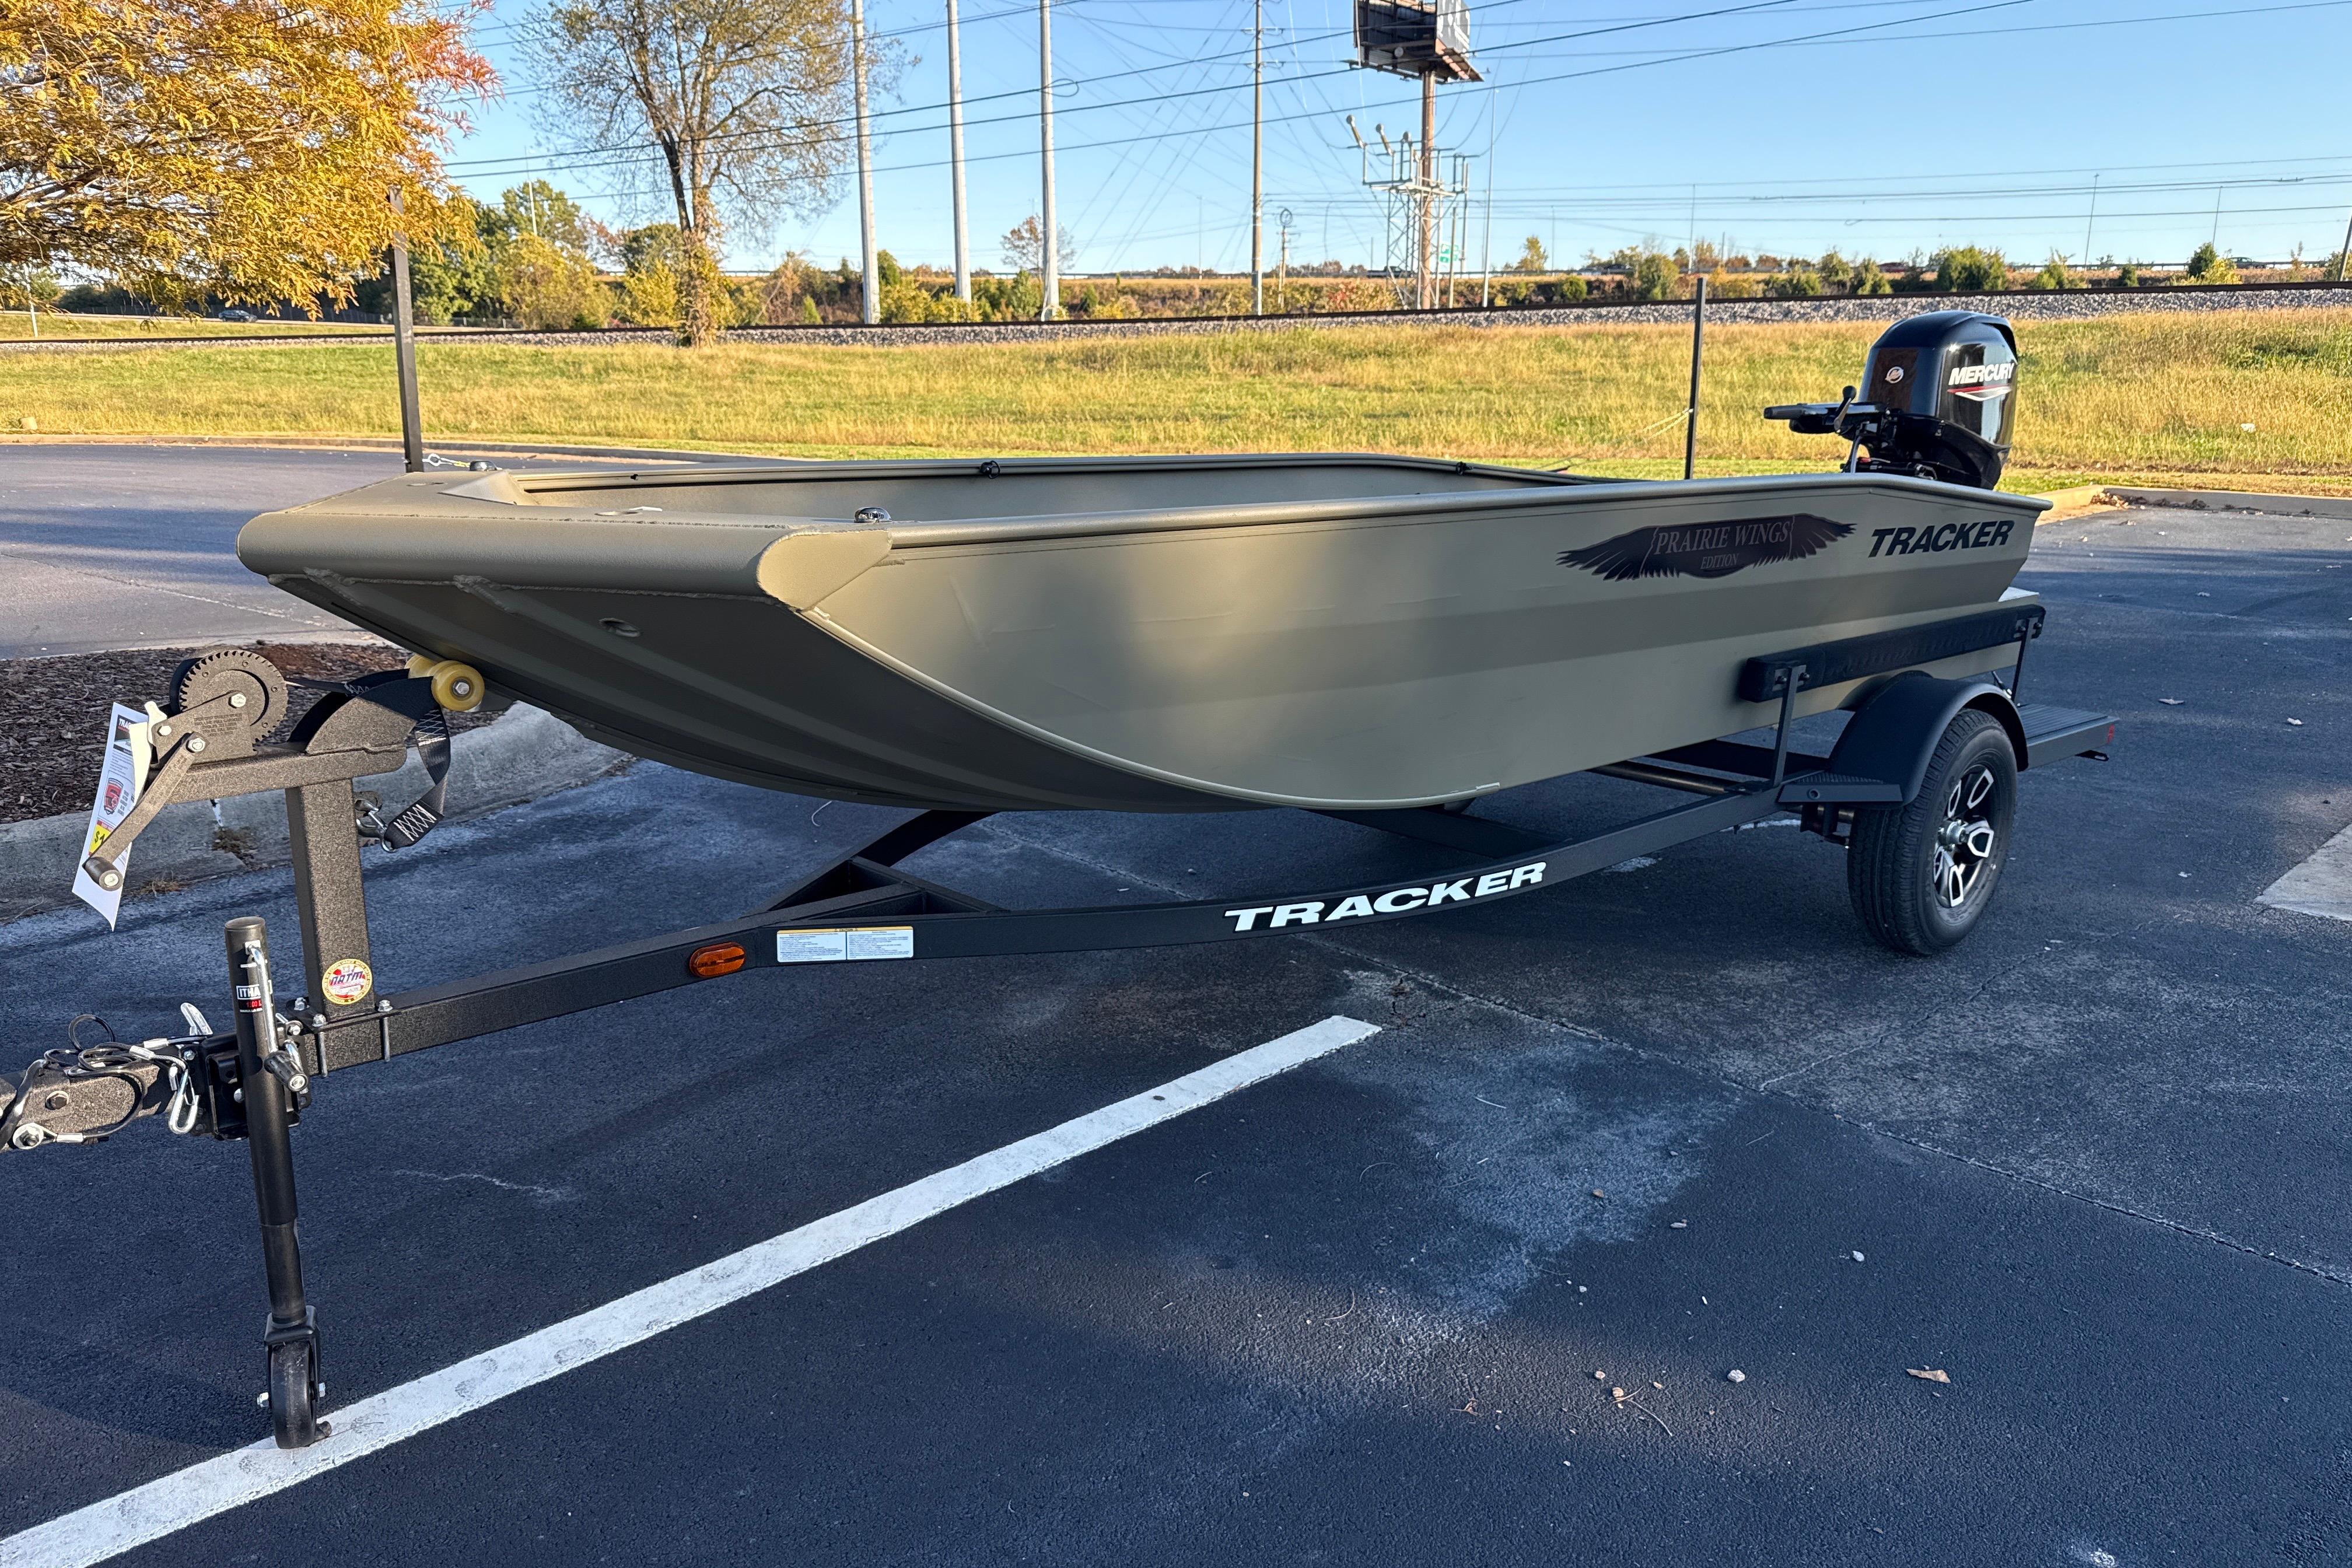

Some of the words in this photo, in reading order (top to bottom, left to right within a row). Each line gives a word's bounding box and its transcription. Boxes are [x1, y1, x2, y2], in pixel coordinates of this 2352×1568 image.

[1948, 363, 2014, 385] MERCURY
[1654, 527, 1731, 555] PRAIRIE
[1735, 521, 1790, 547] WINGS
[1868, 520, 2015, 558] TRACKER
[1700, 553, 1739, 570] EDITION
[1225, 862, 1547, 932] TRACKER
